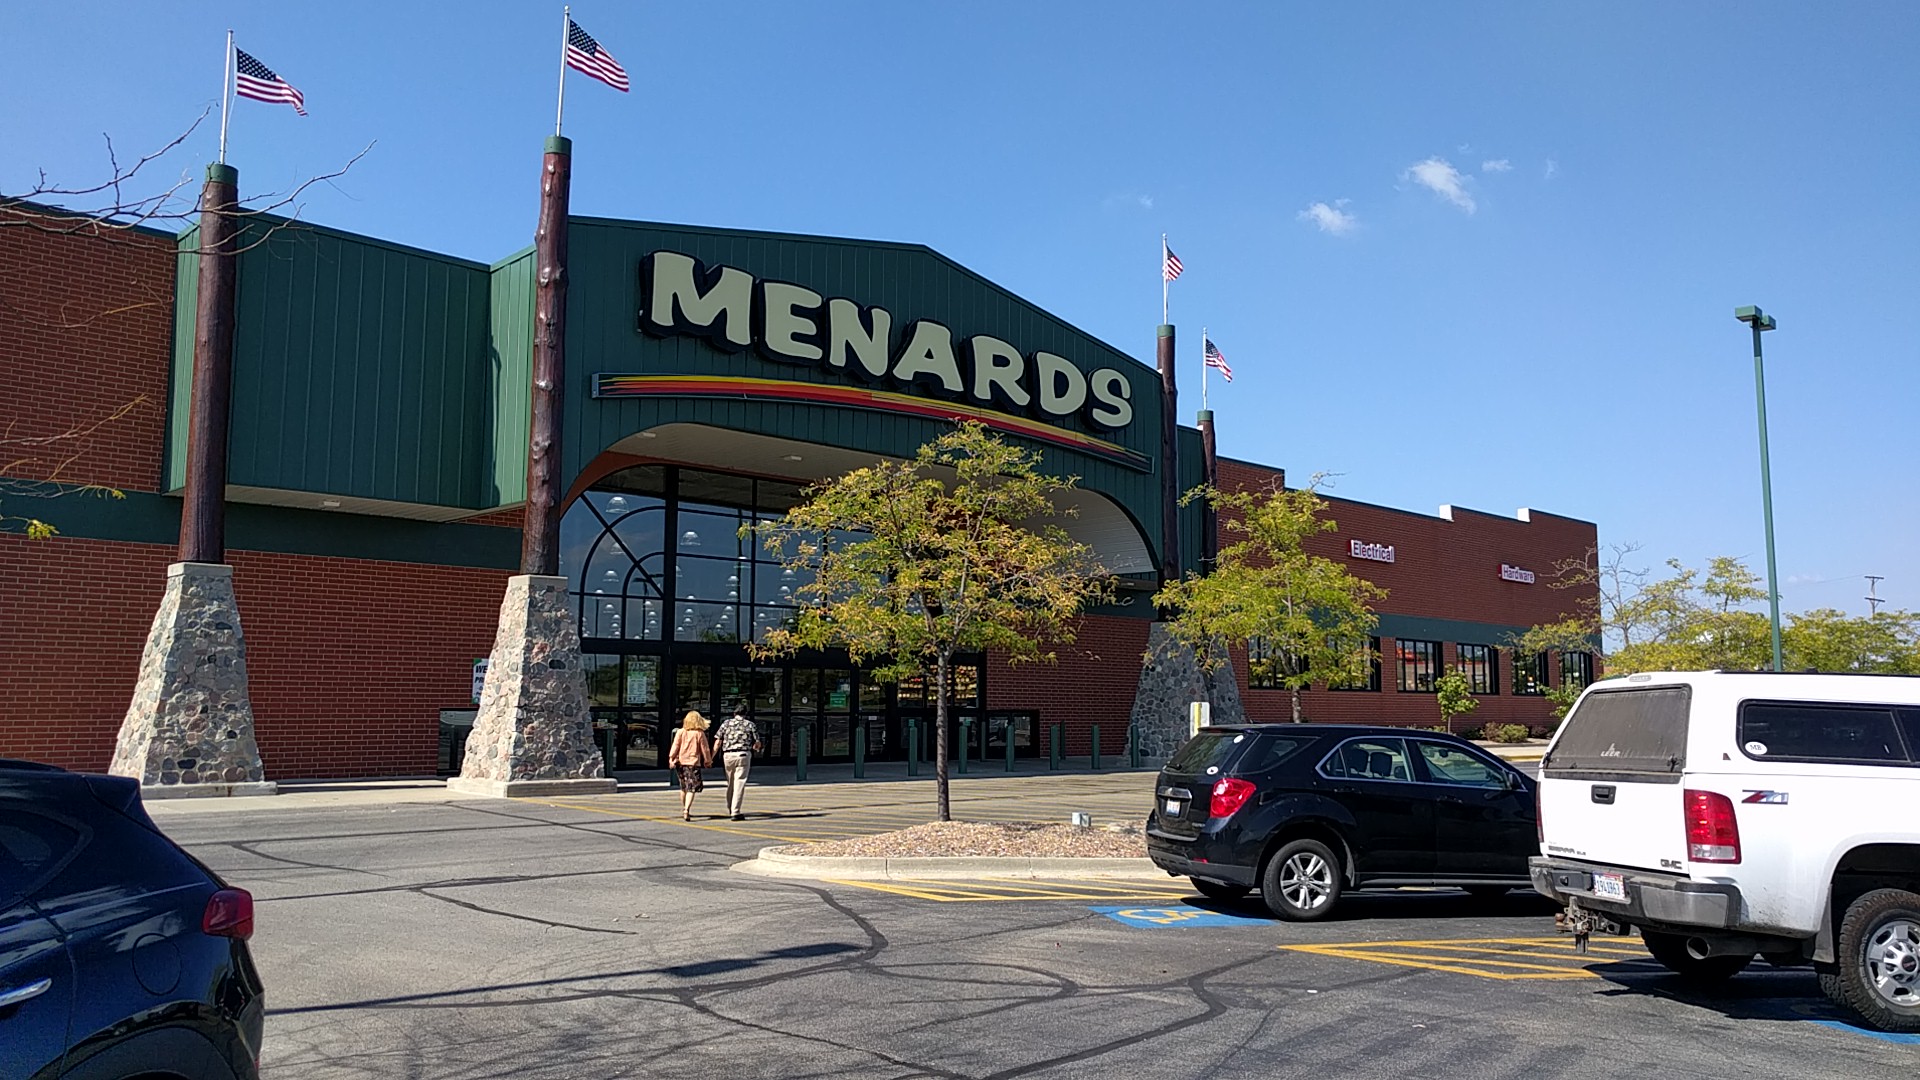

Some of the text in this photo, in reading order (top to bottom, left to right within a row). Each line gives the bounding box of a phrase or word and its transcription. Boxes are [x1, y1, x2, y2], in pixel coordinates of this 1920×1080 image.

[648, 250, 1134, 429] MENARDS
[1351, 540, 1395, 563] Electrical
[1501, 564, 1535, 584] Hardware
[1741, 789, 1789, 805] Z71
[1660, 858, 1683, 870] GMC
